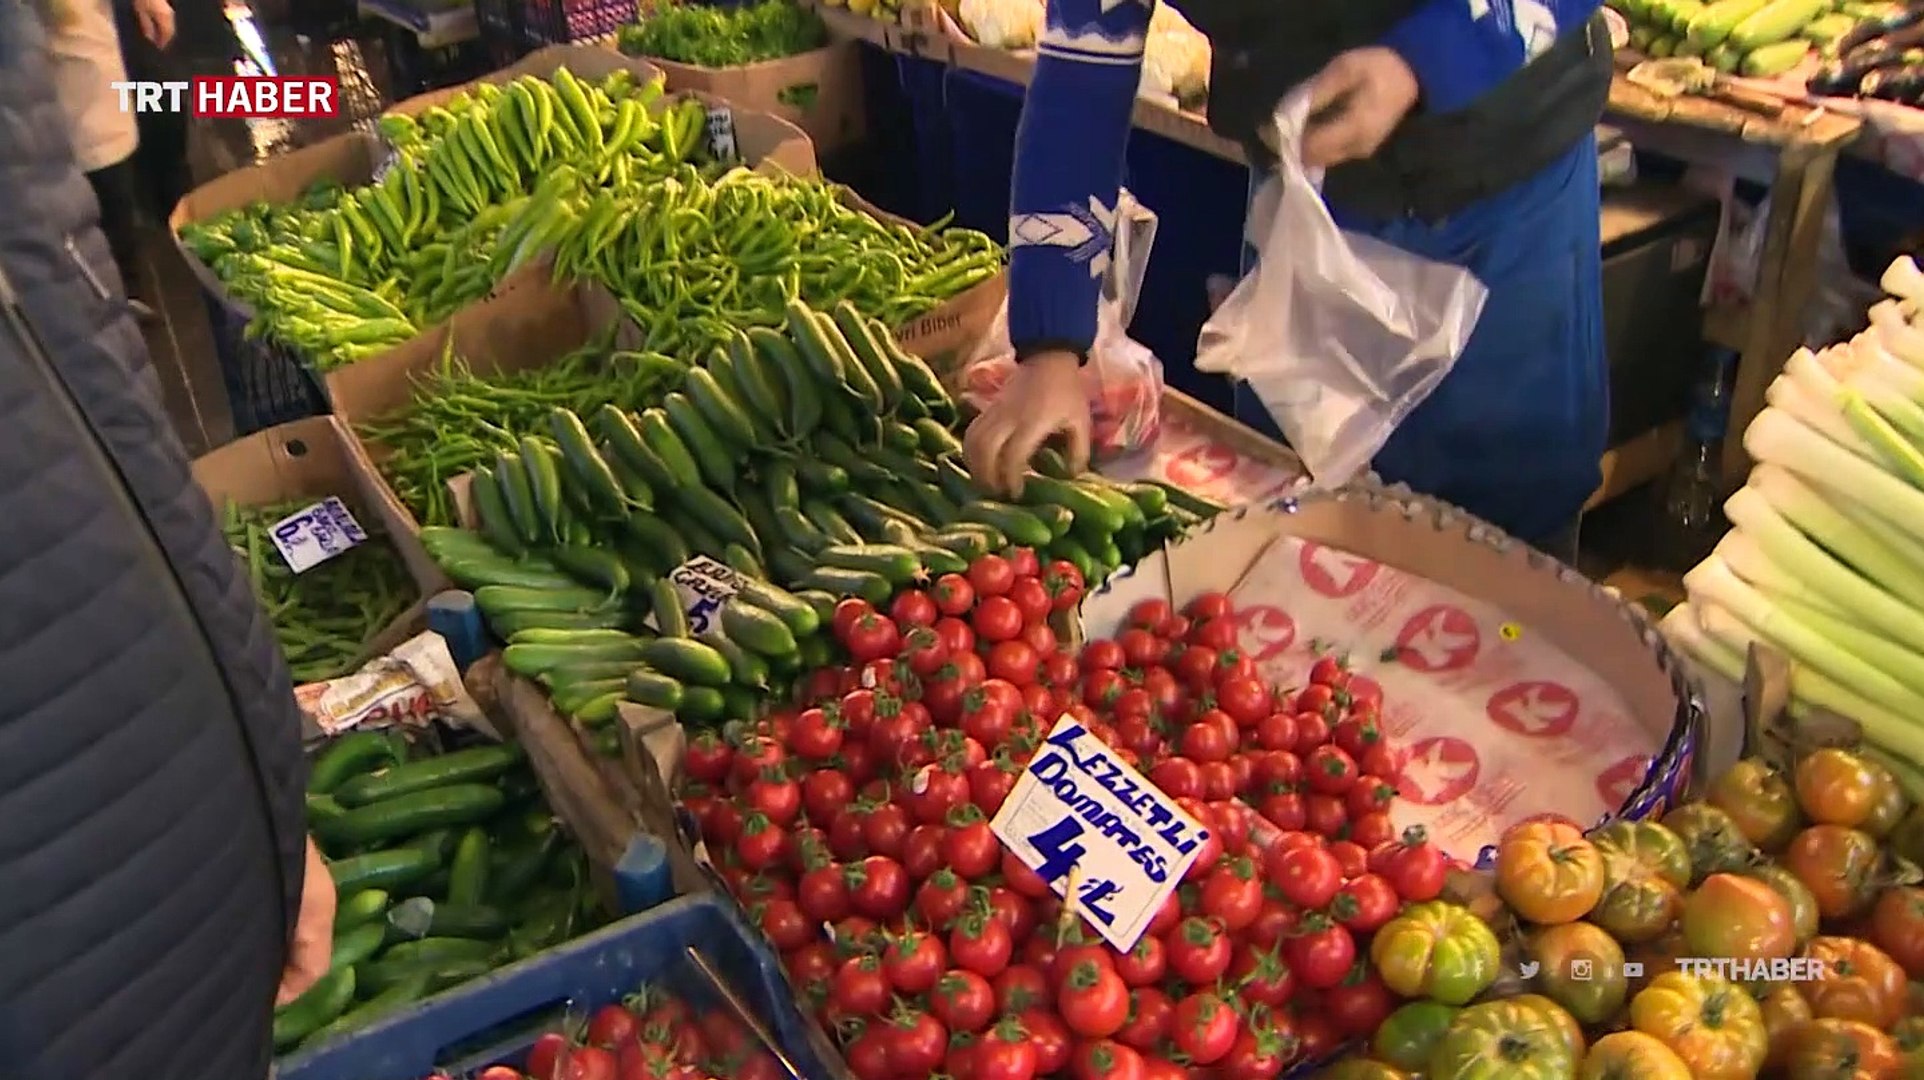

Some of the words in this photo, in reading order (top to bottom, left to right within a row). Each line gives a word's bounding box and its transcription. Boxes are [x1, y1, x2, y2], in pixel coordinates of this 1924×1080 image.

[687, 597, 720, 634] 5
[1027, 815, 1087, 884] 4
[1029, 752, 1167, 884] DOMATES
